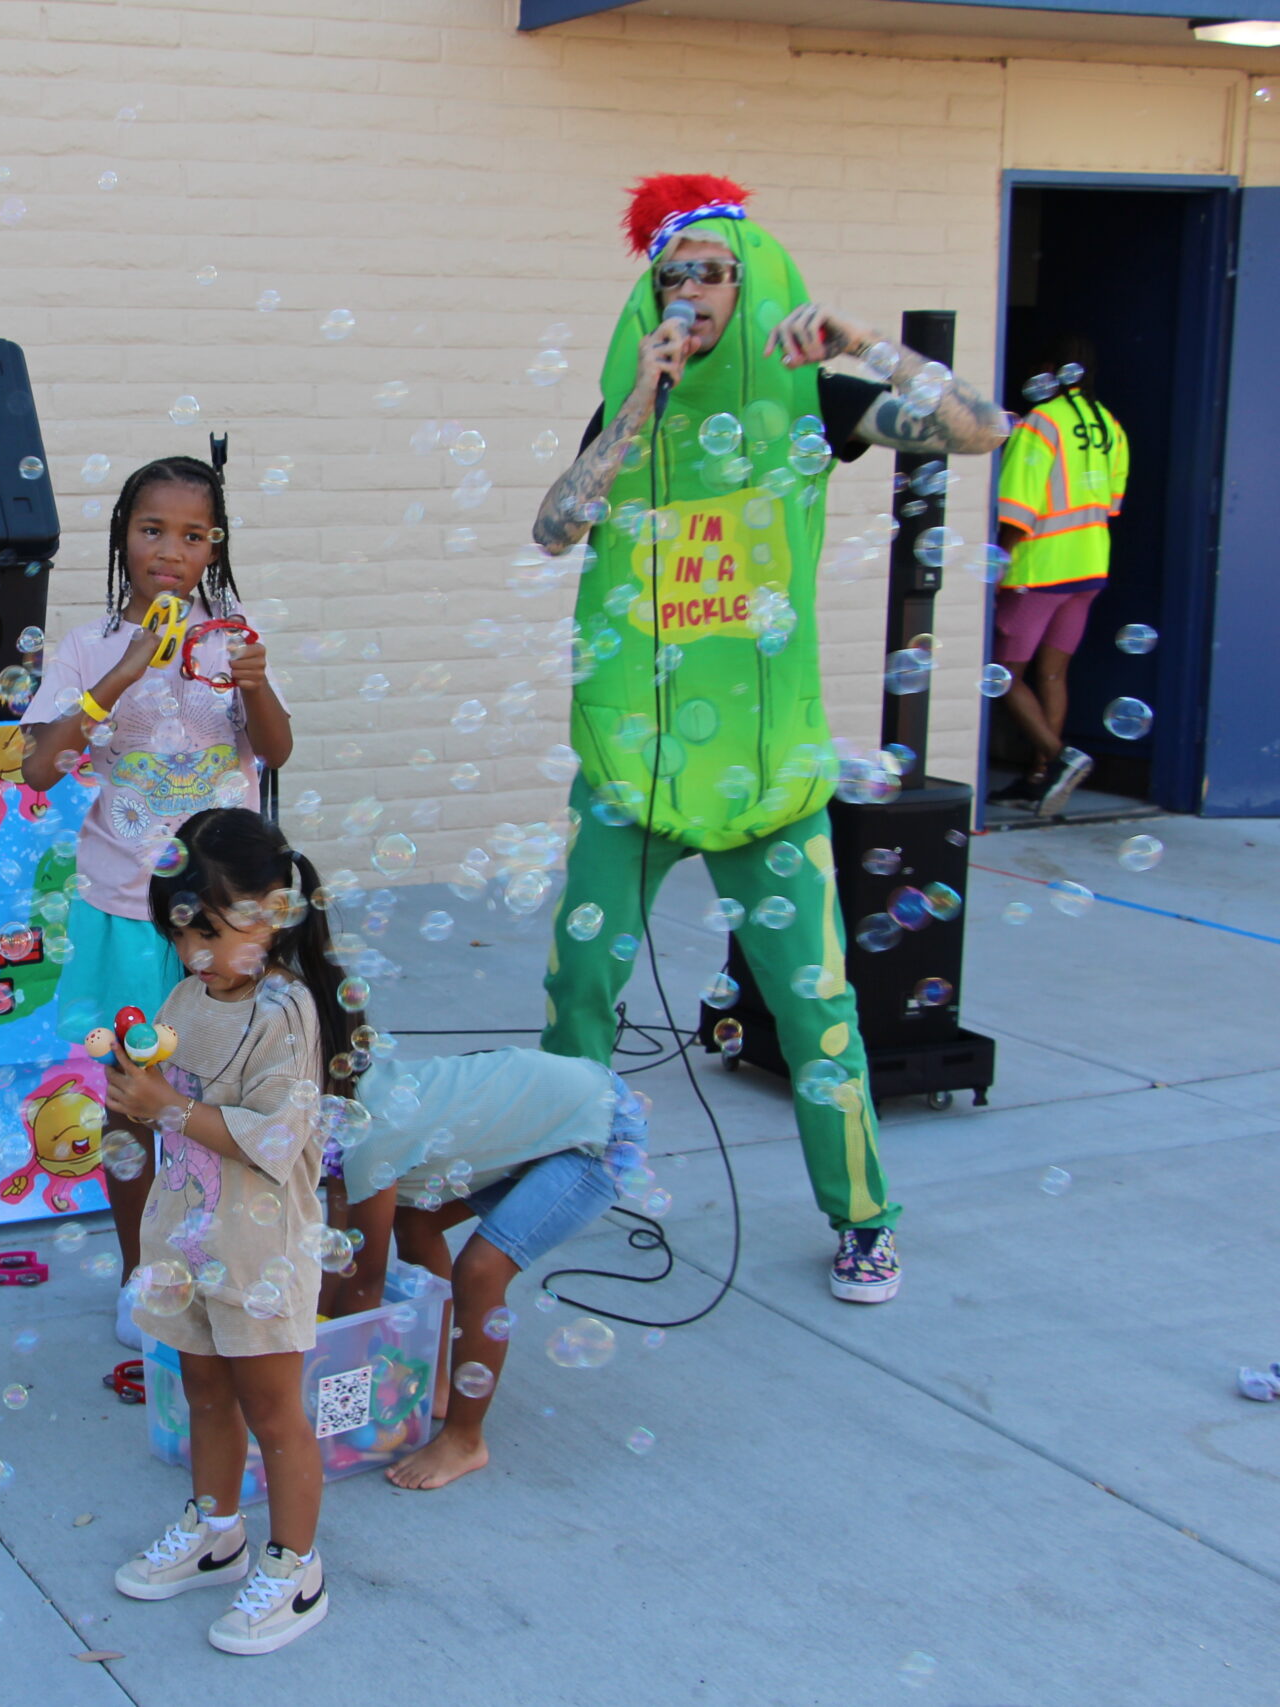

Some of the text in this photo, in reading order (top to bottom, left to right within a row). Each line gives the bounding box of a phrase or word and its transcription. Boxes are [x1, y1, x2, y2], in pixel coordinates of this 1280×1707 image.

[688, 513, 723, 542] I'M
[675, 554, 735, 583] IN A
[661, 594, 752, 629] PICKLE
